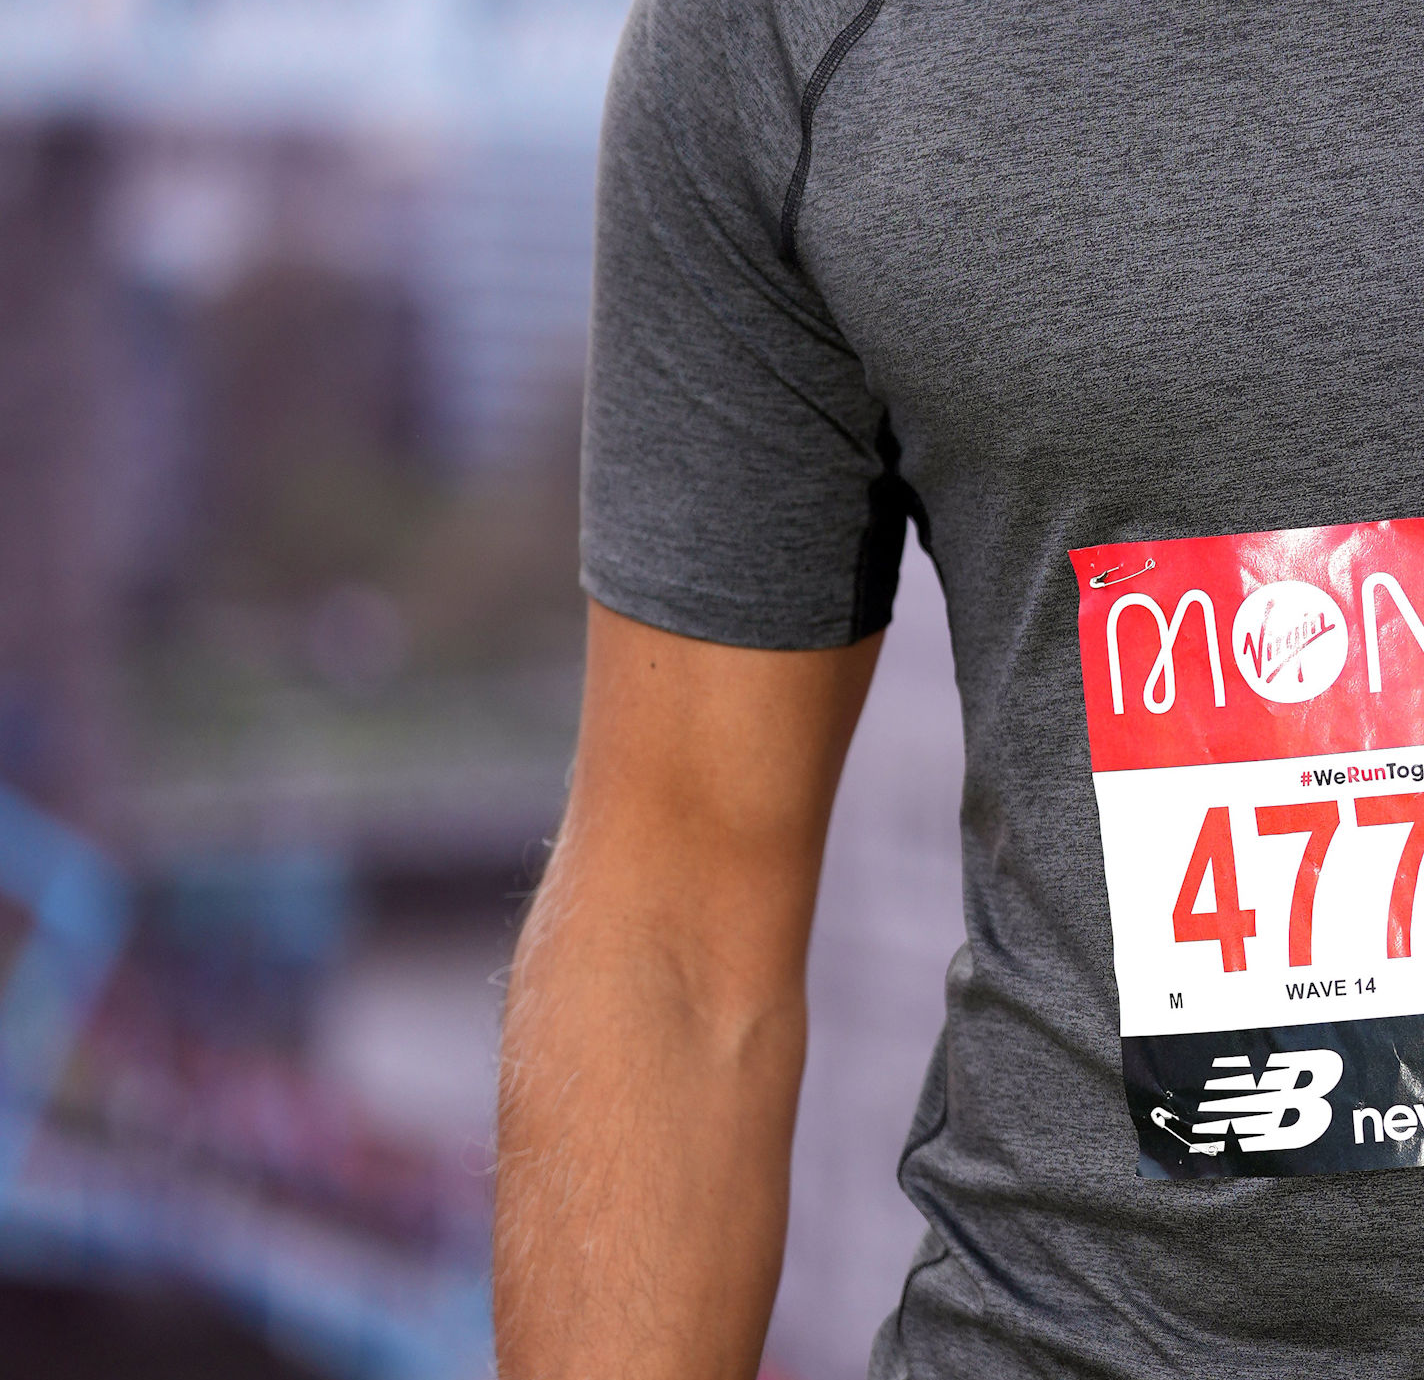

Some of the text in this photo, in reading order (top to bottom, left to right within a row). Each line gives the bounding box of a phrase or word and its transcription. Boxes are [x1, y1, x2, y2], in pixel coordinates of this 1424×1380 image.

[1286, 977, 1377, 1001] WAVE 14
[1169, 992, 1184, 1010] M
